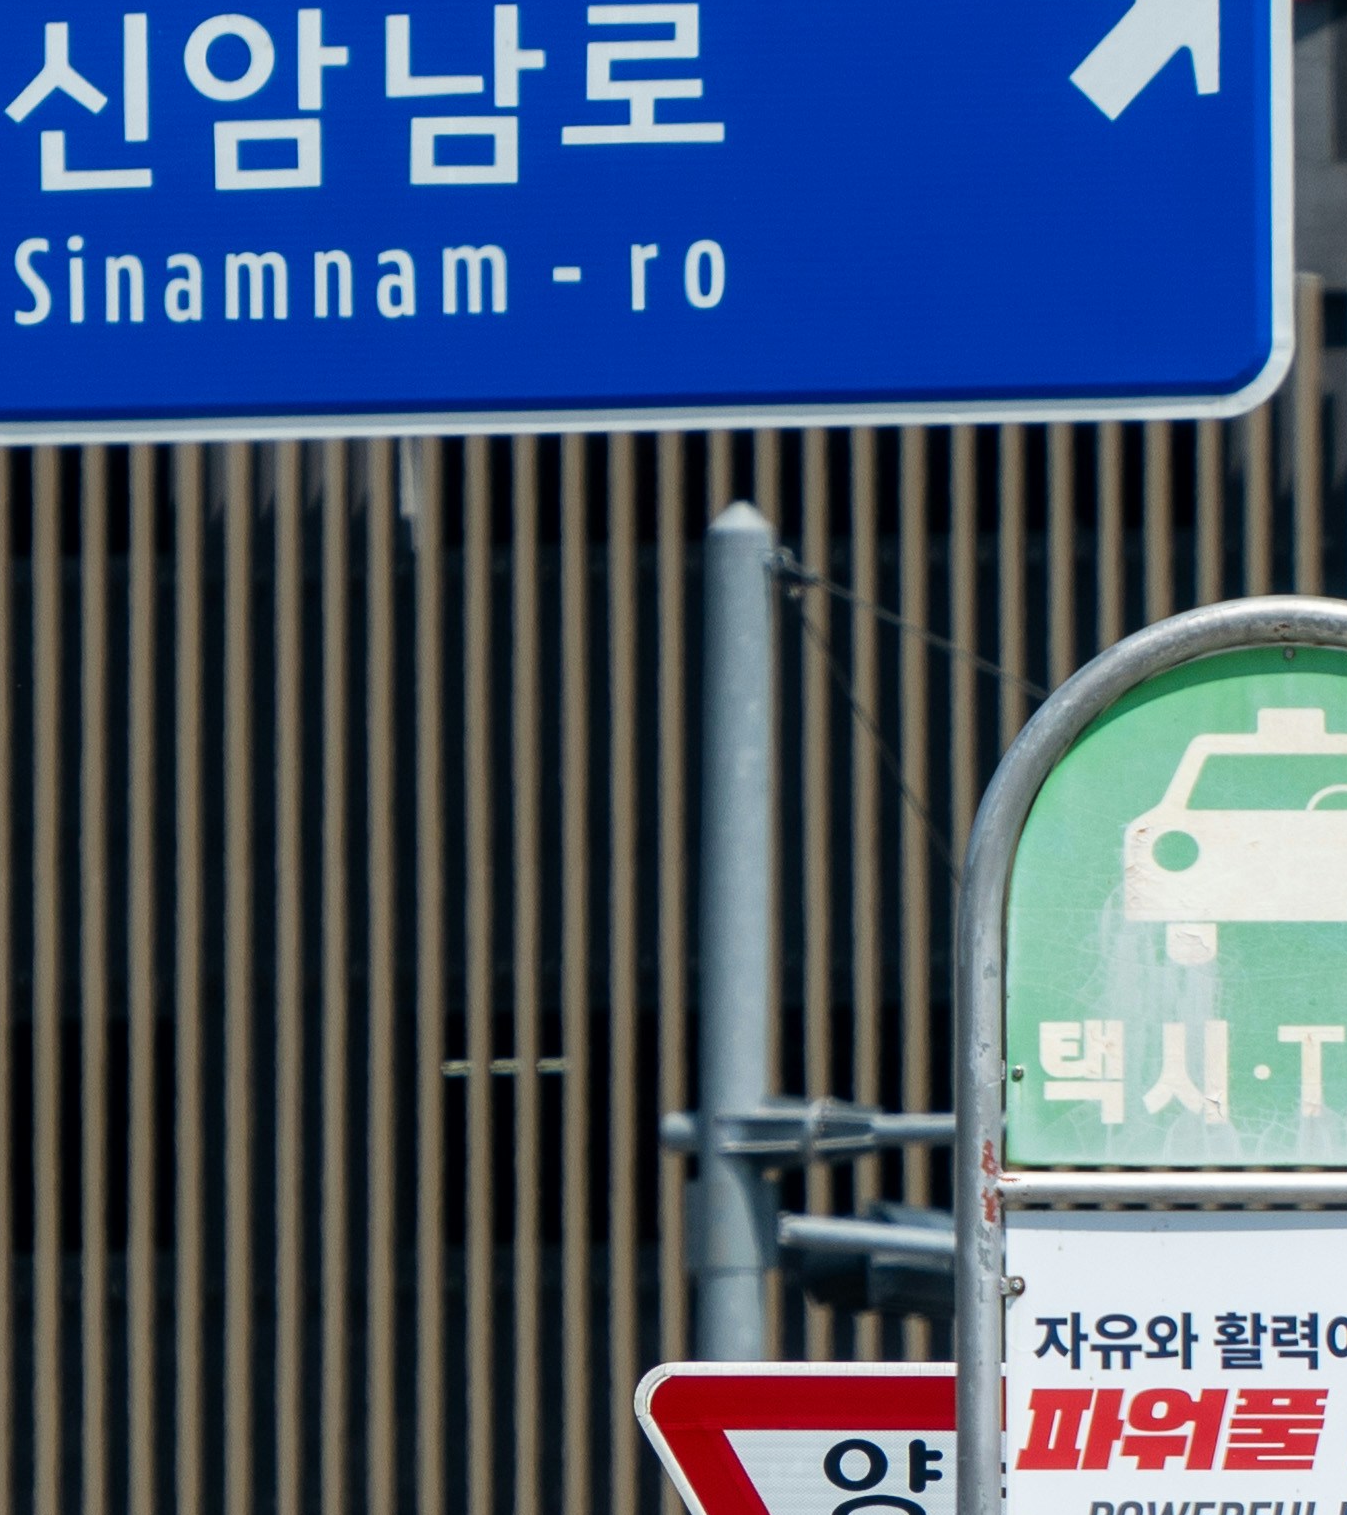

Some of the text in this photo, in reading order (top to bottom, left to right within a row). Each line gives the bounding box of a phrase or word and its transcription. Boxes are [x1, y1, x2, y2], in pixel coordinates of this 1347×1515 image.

[4, 3, 725, 191] 신암남로
[1034, 1312, 1199, 1370] 자유와
[1015, 1388, 1330, 1471] 파워풀
